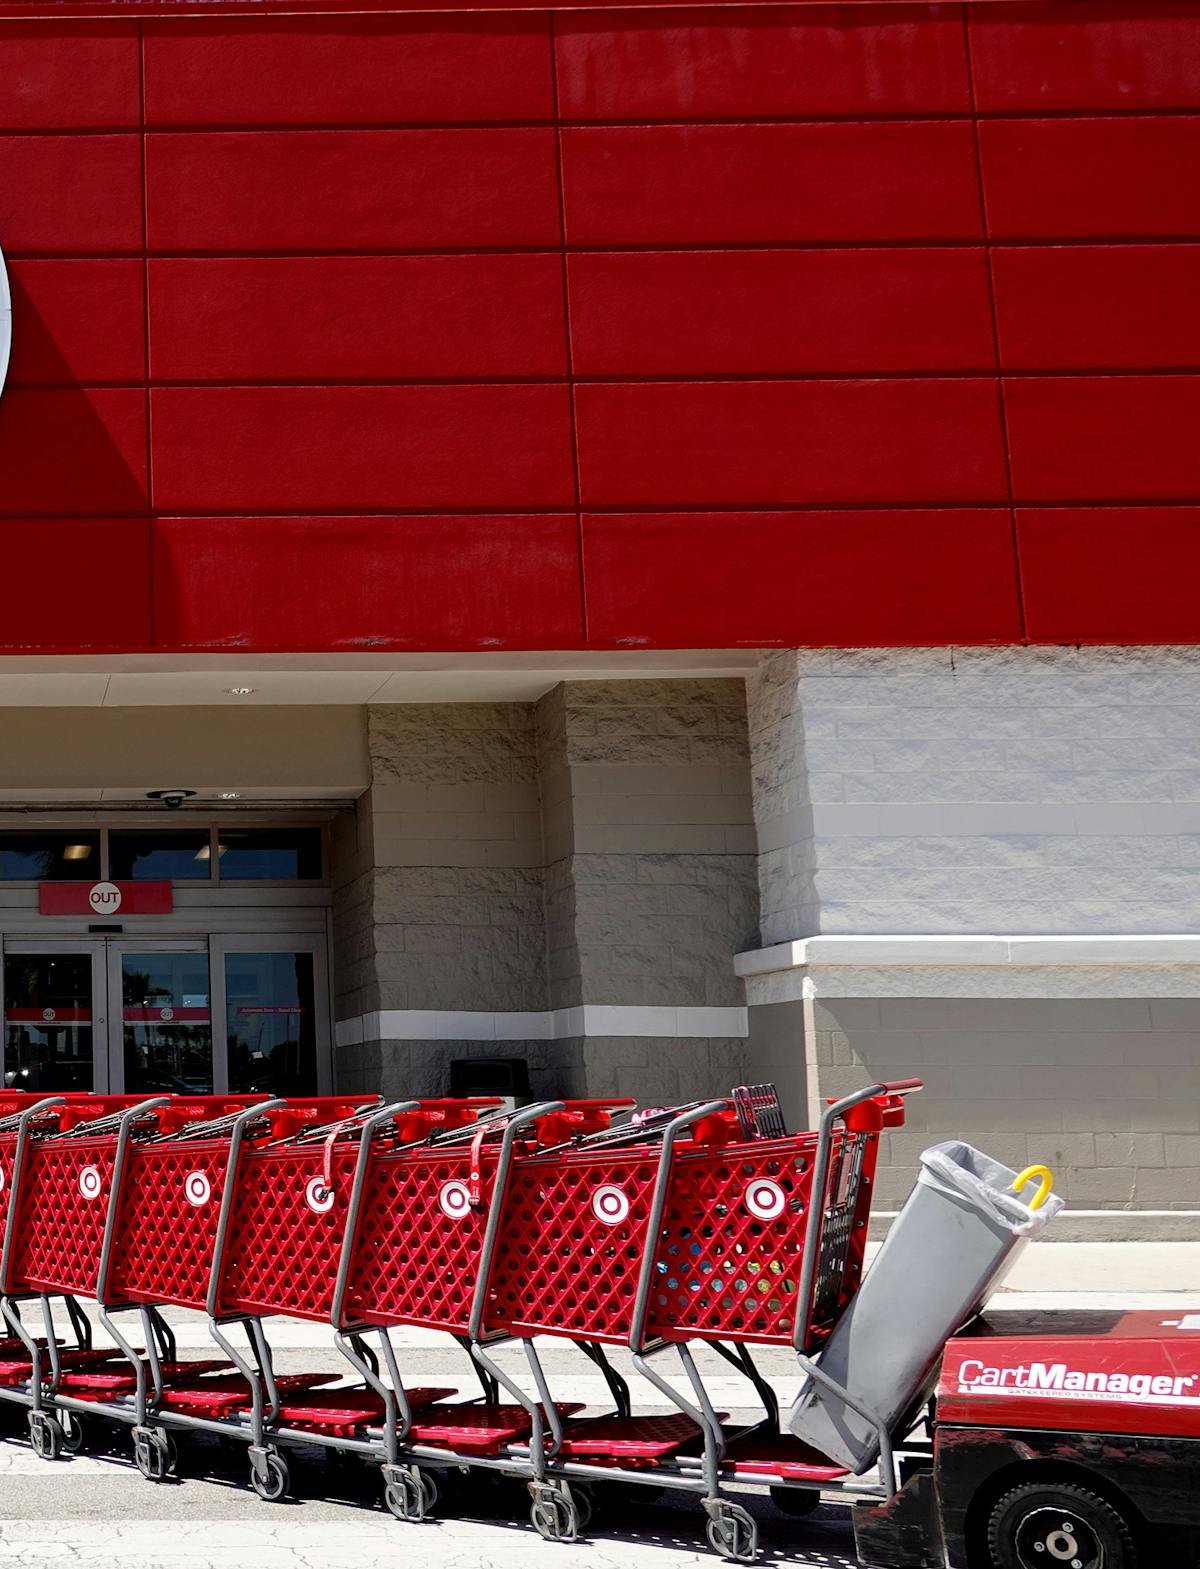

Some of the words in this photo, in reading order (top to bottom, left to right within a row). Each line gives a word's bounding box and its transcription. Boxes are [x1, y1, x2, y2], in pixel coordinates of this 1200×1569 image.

[90, 892, 120, 903] OUT
[1007, 1388, 1071, 1398] GATEKEEPER
[1073, 1391, 1123, 1400] SYSTEMS
